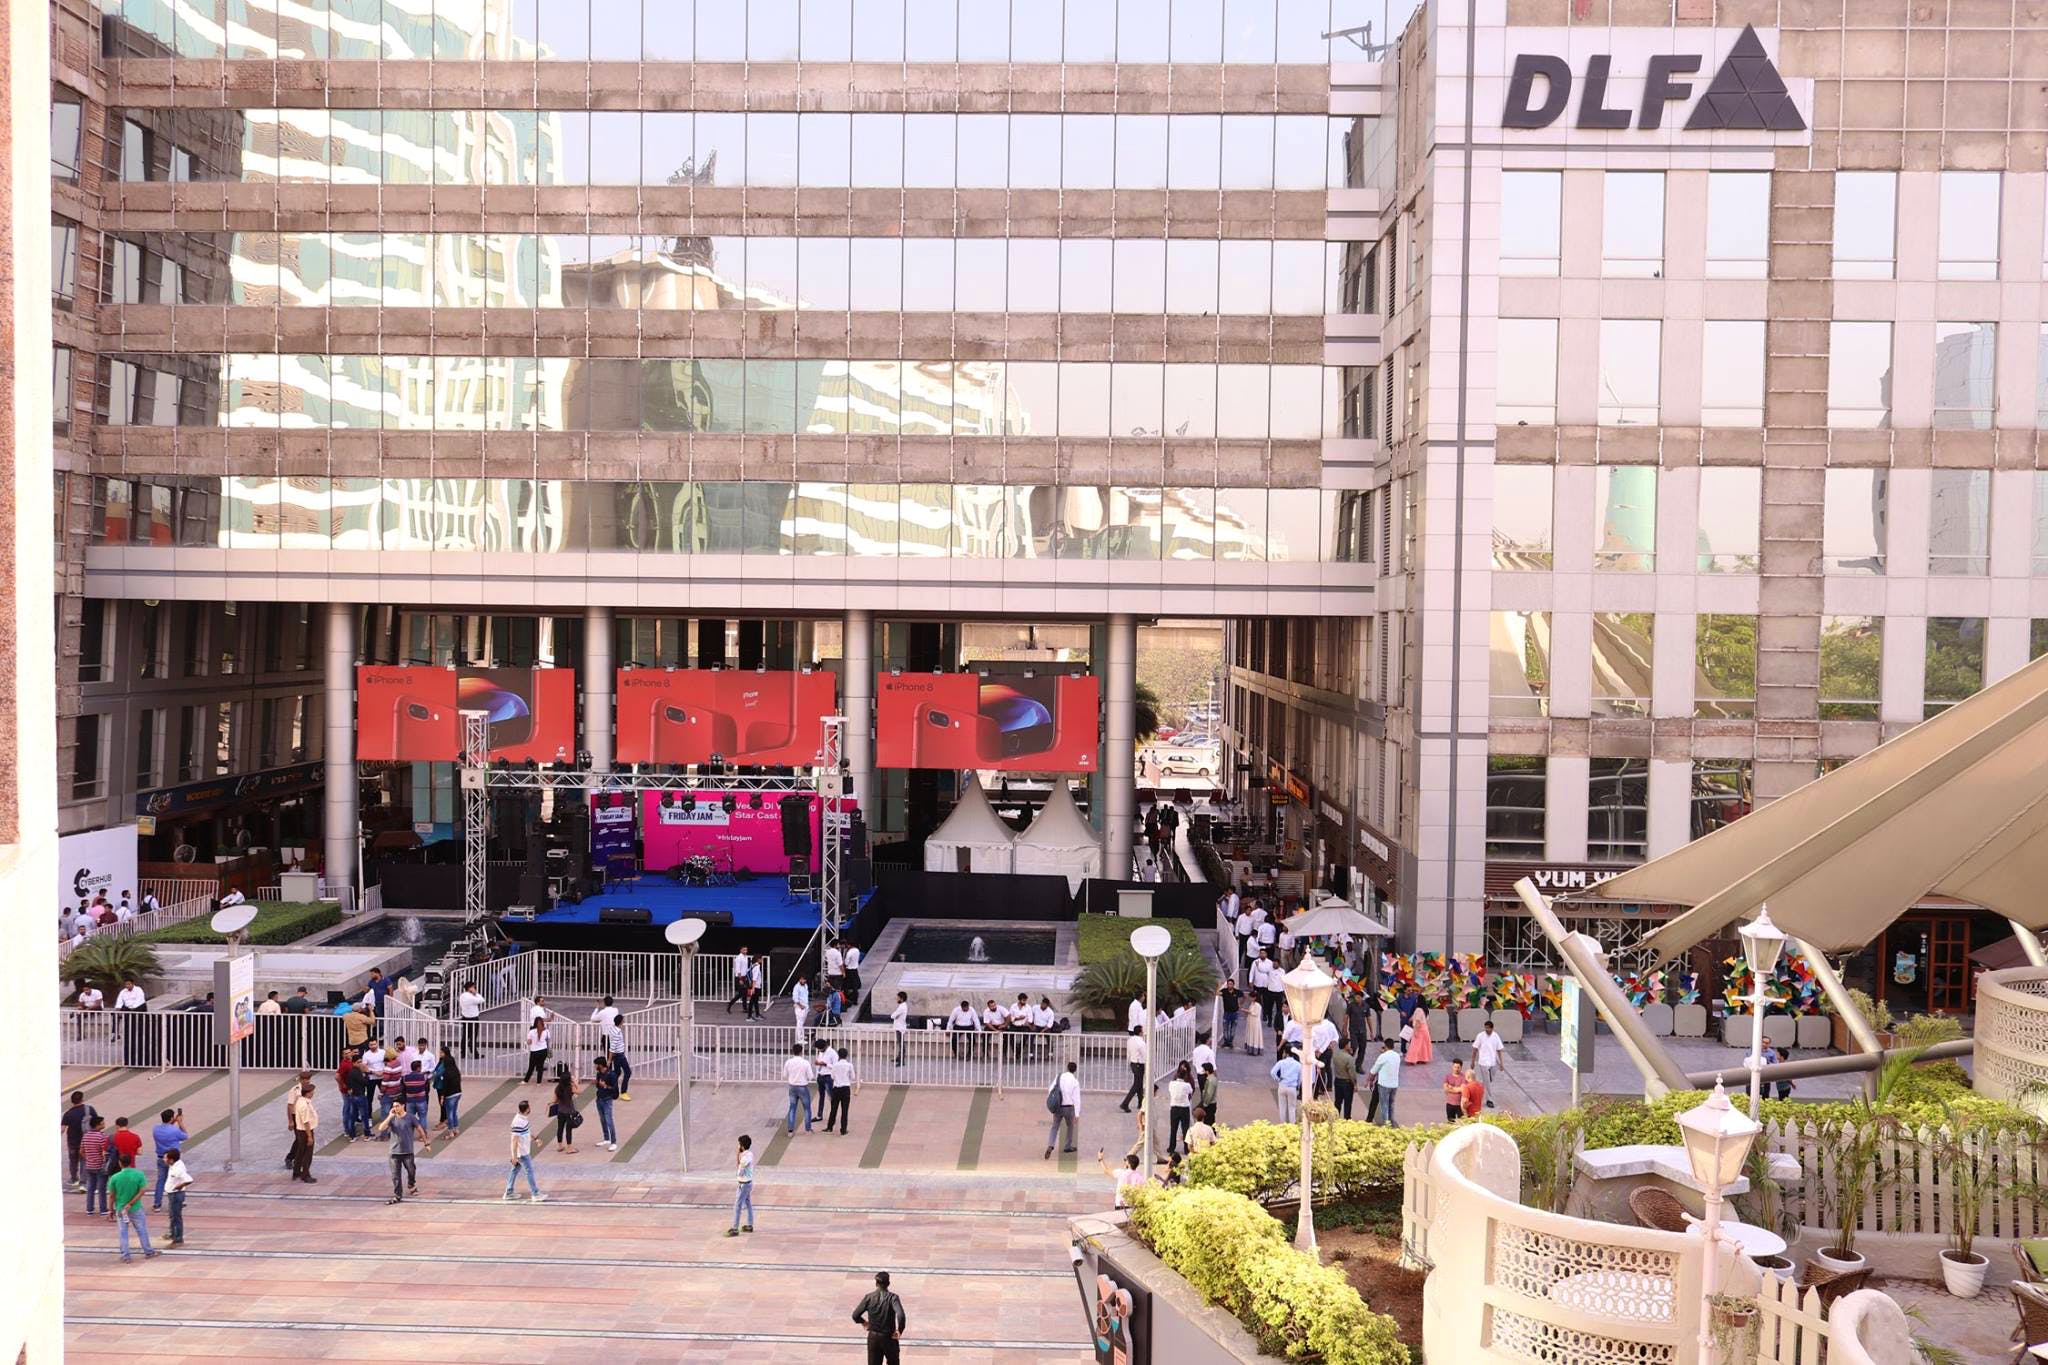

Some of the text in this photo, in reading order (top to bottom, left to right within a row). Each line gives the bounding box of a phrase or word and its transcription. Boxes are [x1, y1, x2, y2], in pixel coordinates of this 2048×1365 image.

[1501, 54, 1702, 129] DLF
[375, 675, 413, 684] iPhone 8
[632, 679, 661, 687] iPhone
[894, 682, 934, 692] iPhone 8
[668, 812, 696, 821] FRIDAY
[696, 812, 713, 821] JAM
[735, 812, 755, 820] Star
[756, 812, 777, 820] Cast
[1534, 870, 1586, 888] YUM
